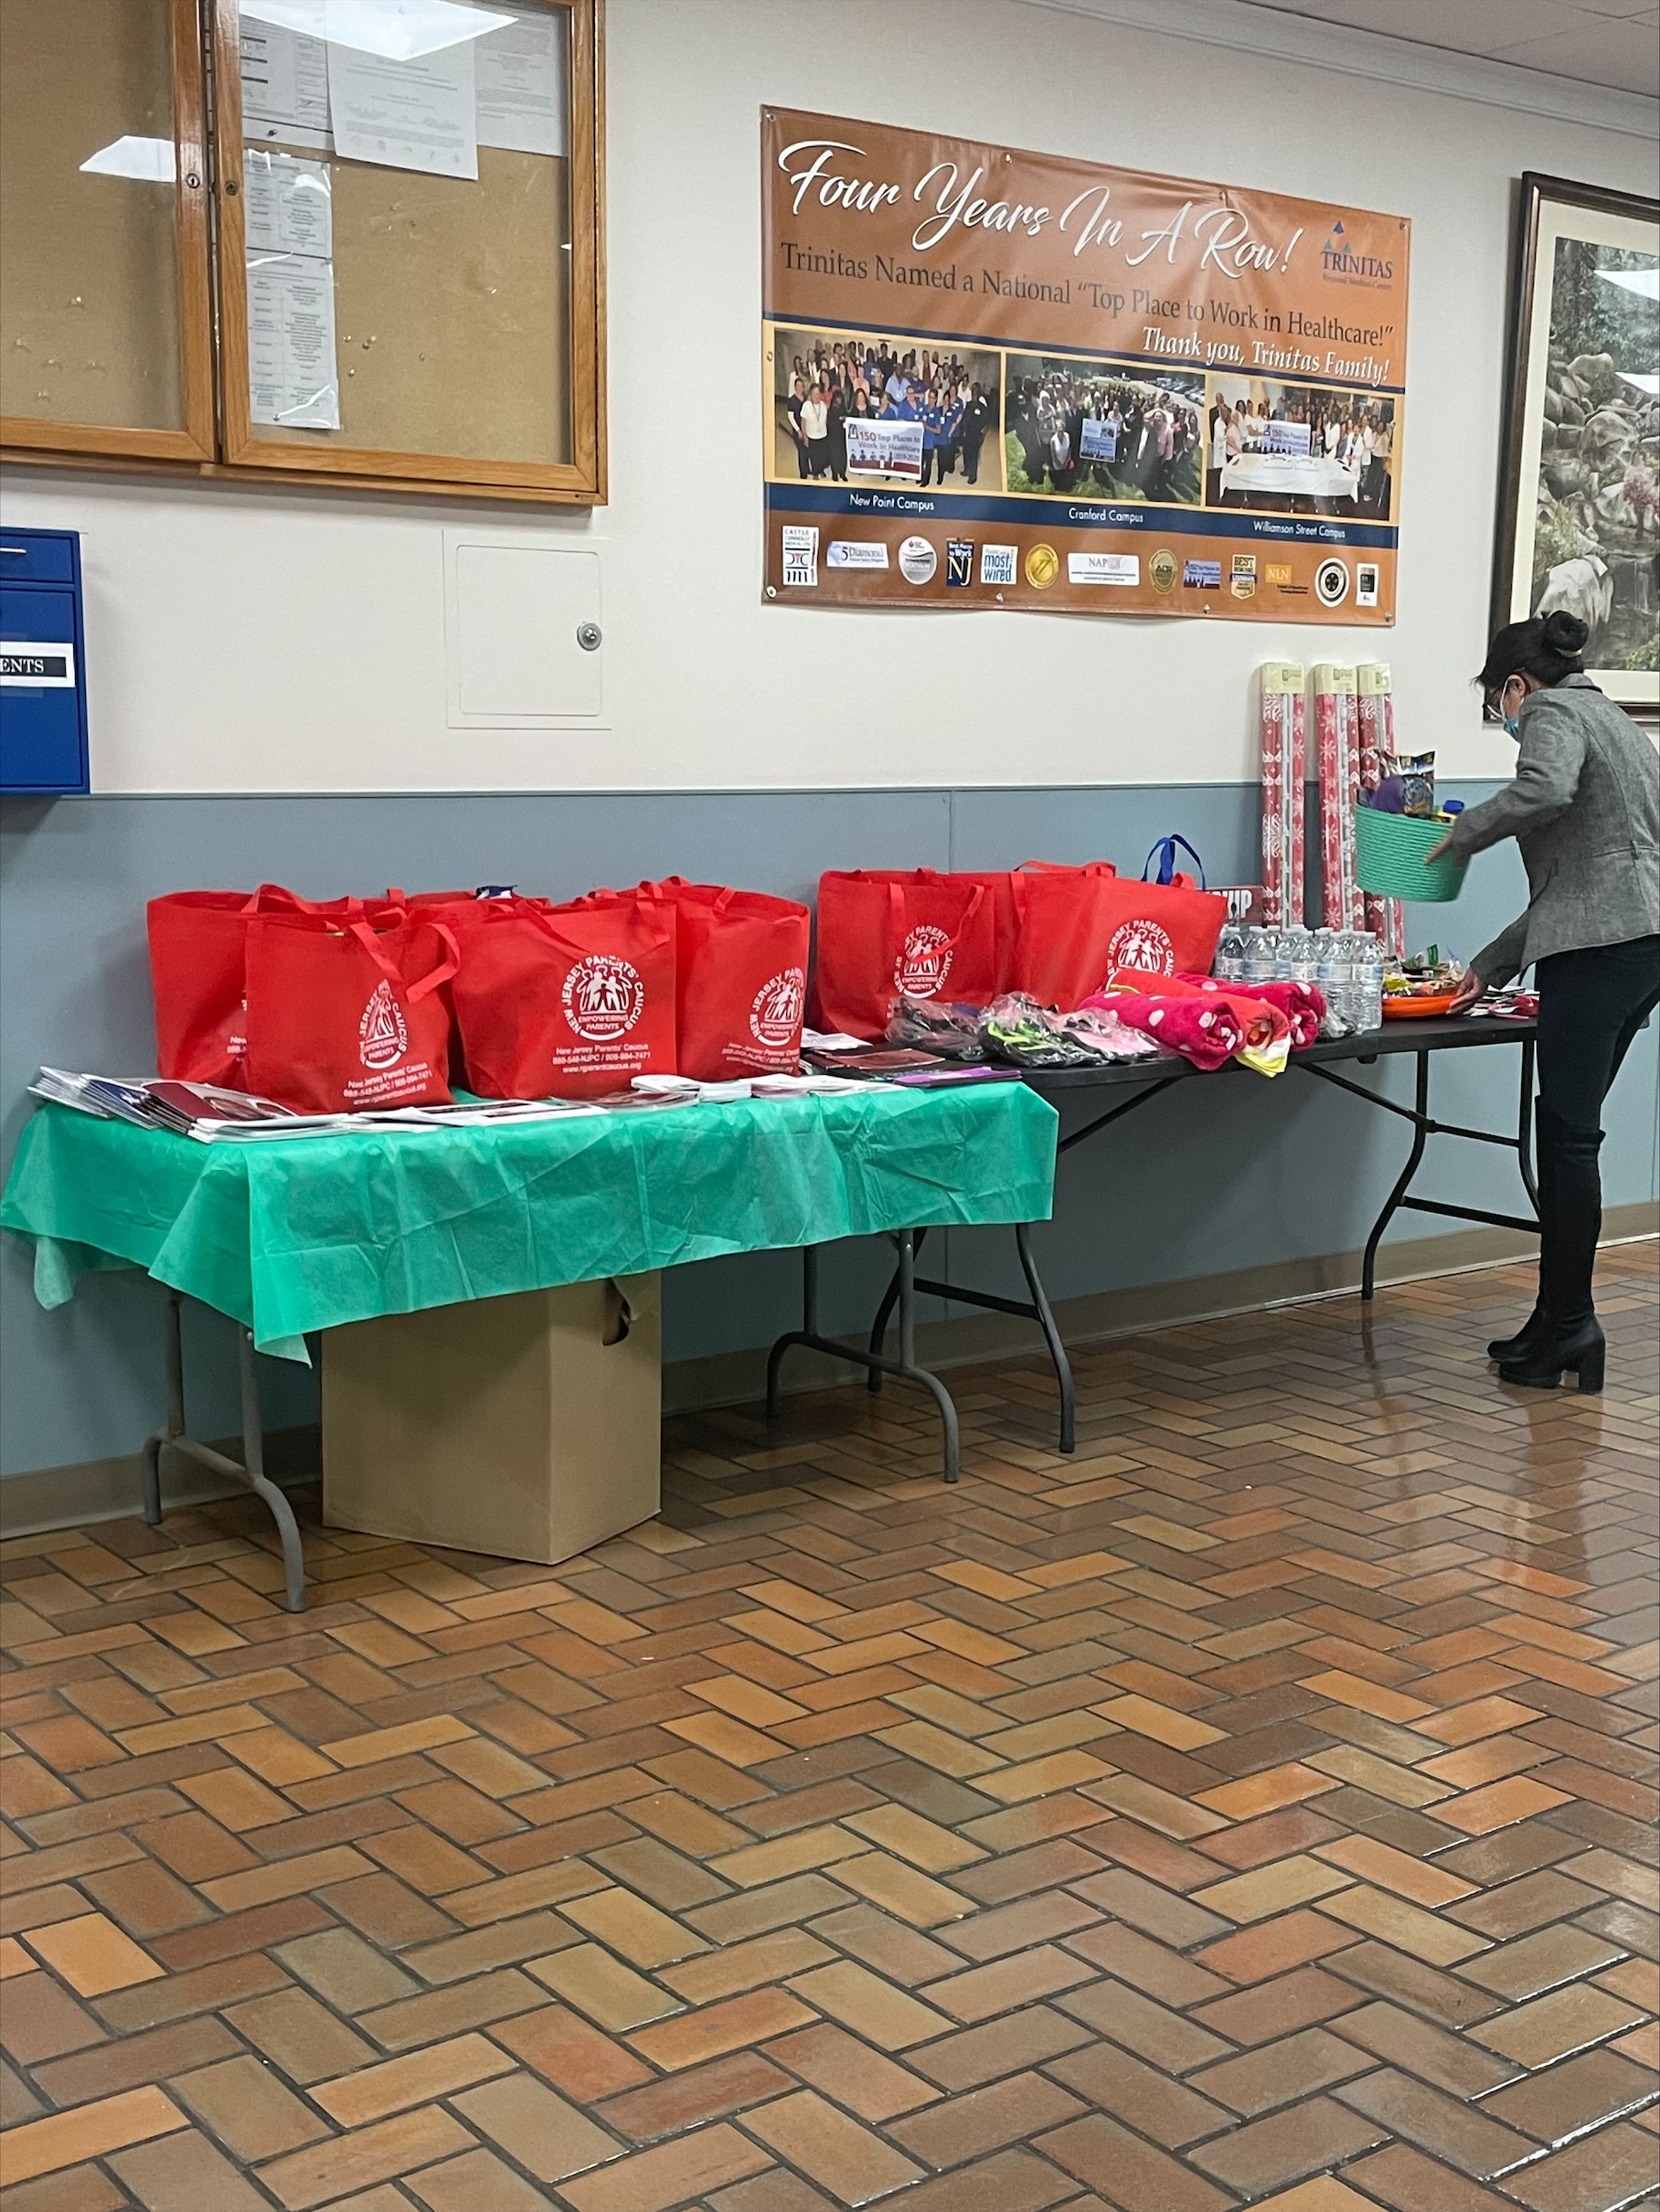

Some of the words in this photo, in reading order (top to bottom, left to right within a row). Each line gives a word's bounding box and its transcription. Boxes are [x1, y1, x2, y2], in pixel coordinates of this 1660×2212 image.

[778, 140, 902, 216] Four
[912, 162, 1053, 251] Years
[1059, 186, 1126, 257] In
[1125, 201, 1193, 266] A
[1195, 207, 1304, 279] Row!
[1321, 250, 1393, 279] TRINITAS
[781, 241, 867, 279] Trinitas
[876, 255, 956, 290] Named
[963, 272, 974, 292] a
[983, 269, 1070, 304] National
[1133, 289, 1180, 318] Place
[1187, 298, 1205, 321] to
[1210, 300, 1258, 330] Work
[1263, 308, 1281, 333] in
[1143, 326, 1201, 356] Thank
[1206, 339, 1245, 367] you,
[1251, 341, 1320, 374] Trinitas
[1325, 351, 1390, 388] Family!
[860, 431, 876, 441] 150
[849, 494, 870, 506] New
[873, 495, 895, 508] Point
[897, 496, 934, 513] Campus
[1069, 507, 1106, 521] Cranford
[1108, 509, 1144, 524] Campus
[1253, 520, 1293, 534] Williamson
[1295, 524, 1317, 536] Street
[1318, 526, 1346, 538] Campus
[841, 547, 848, 561] 5
[849, 547, 884, 558] Diamond
[984, 553, 1010, 569] most
[1234, 556, 1254, 567] BEST
[948, 556, 973, 586] NJ
[984, 563, 1012, 582] wired
[1267, 568, 1290, 580] NLN
[1108, 922, 1130, 957] JERSEY
[916, 925, 950, 945] PARENT
[935, 951, 953, 991] CAUCUS
[561, 962, 585, 1005] JERSEY
[752, 973, 782, 1012] JERSEY
[623, 982, 644, 1030] CAUCUS
[392, 1003, 408, 1052] CAUCUS
[563, 1008, 582, 1034] NEW
[578, 1014, 629, 1024] EMPOWERING
[585, 1023, 620, 1031] PARENTS
[750, 1014, 762, 1037] NEW
[555, 1048, 571, 1056] New
[572, 1046, 593, 1055] Jersey
[623, 1043, 649, 1051] Caucus
